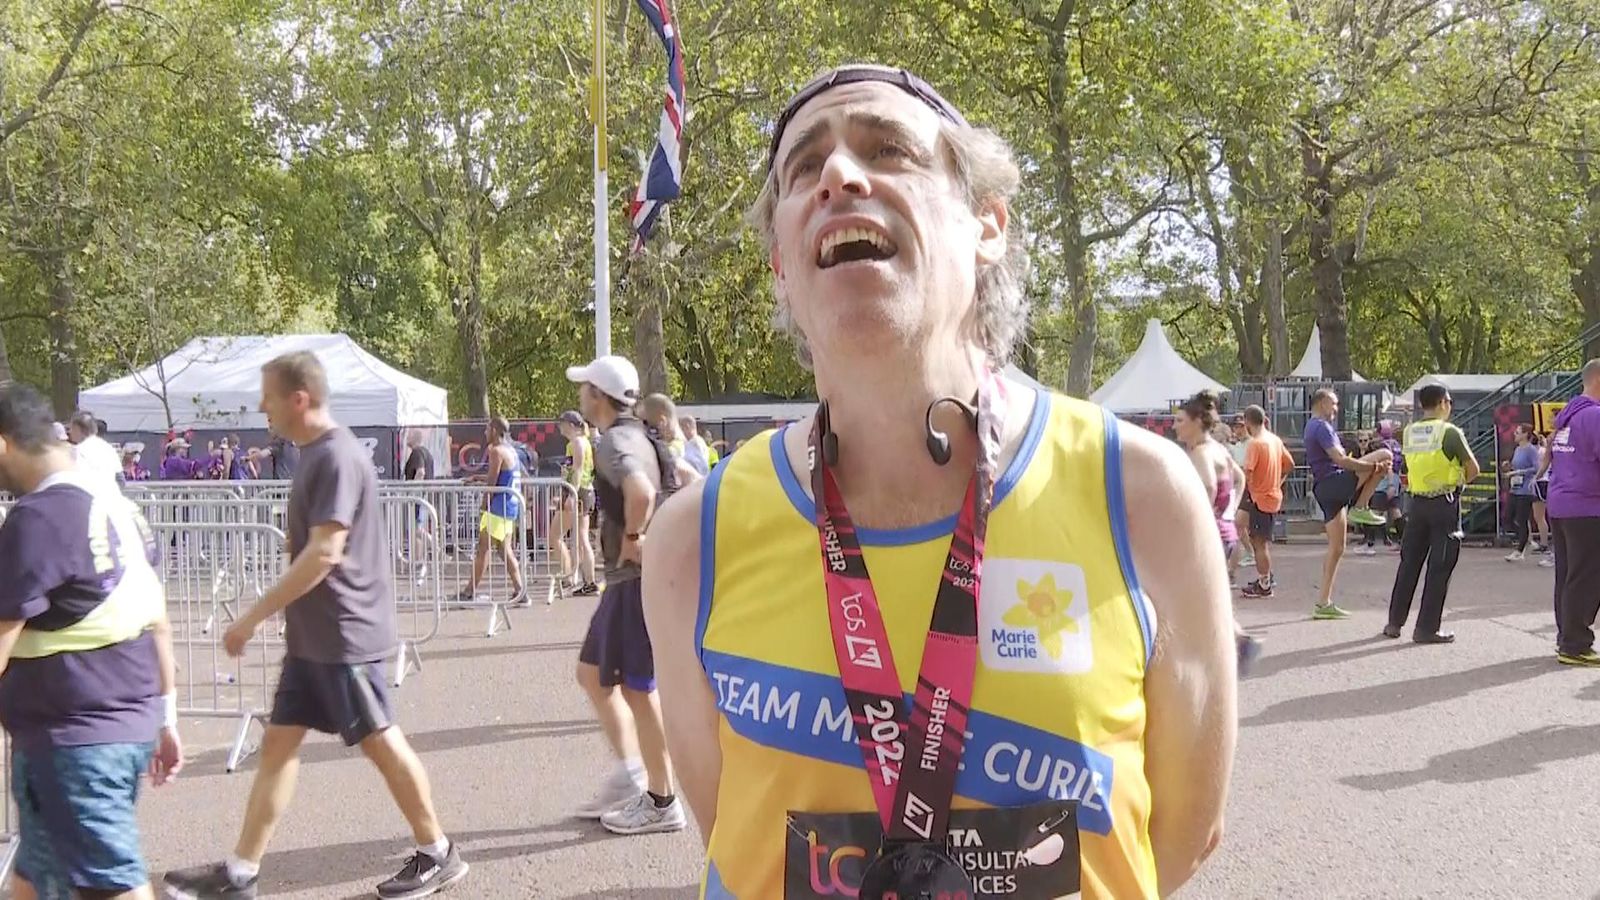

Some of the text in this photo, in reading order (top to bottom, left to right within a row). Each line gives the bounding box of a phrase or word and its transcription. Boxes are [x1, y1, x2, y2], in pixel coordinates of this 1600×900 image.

[991, 629, 1037, 644] Marie
[997, 643, 1038, 659] Curie
[920, 687, 951, 772] FINISHER
[712, 672, 1104, 812] TEAM CURIE
[959, 850, 1032, 871] SULTA
[972, 875, 1017, 894] ICES
